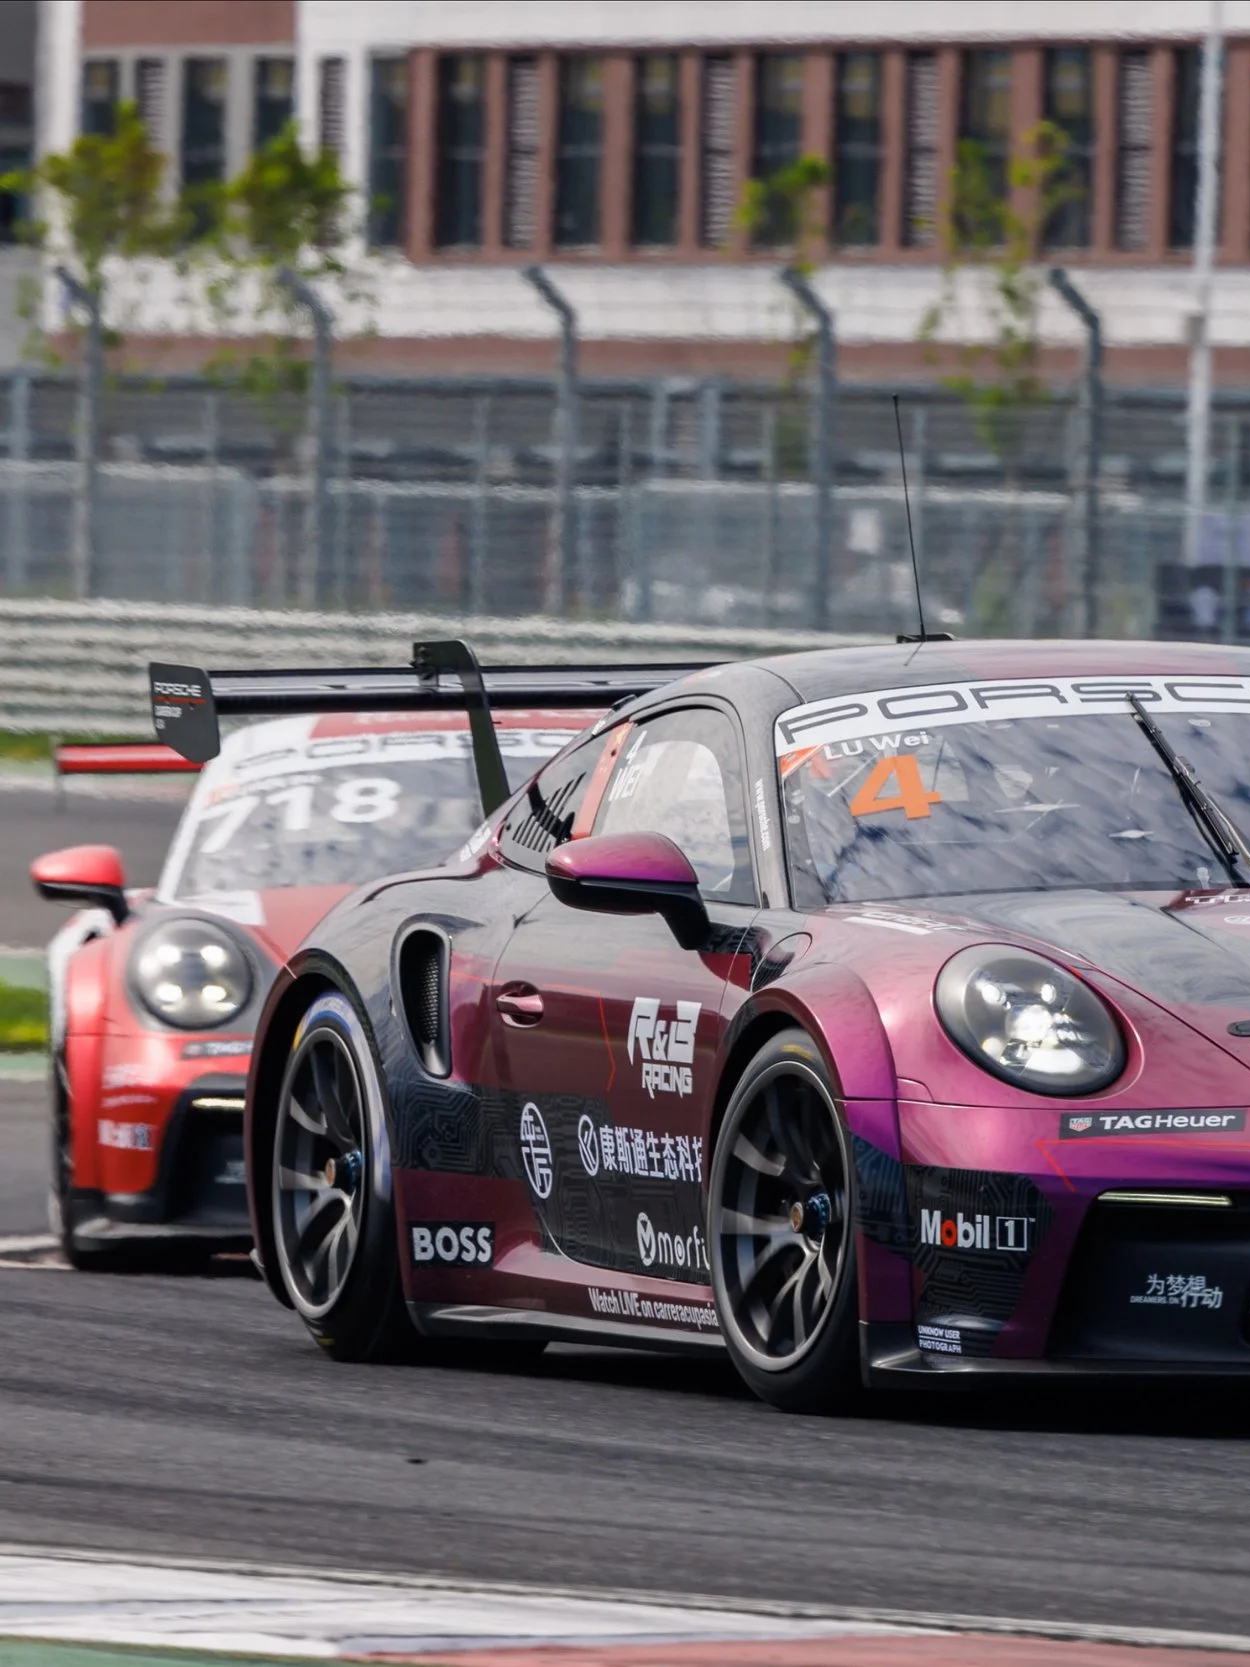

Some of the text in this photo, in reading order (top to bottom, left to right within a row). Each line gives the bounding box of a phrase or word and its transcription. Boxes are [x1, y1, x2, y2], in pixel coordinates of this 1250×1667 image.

[823, 731, 929, 760] LU Wei
[851, 754, 941, 820] 4
[196, 778, 402, 853] 718
[642, 1062, 692, 1099] RACING
[921, 1209, 990, 1249] Mobil
[412, 1227, 492, 1262] BOSS
[1146, 1273, 1206, 1296] 为梦想
[1180, 1286, 1223, 1308] 行动
[588, 1287, 618, 1313] Watch
[618, 1290, 642, 1316] LIVE
[641, 1299, 653, 1317] on
[919, 1339, 962, 1354] PHOTOGRAPH
[944, 1328, 961, 1340] USER
